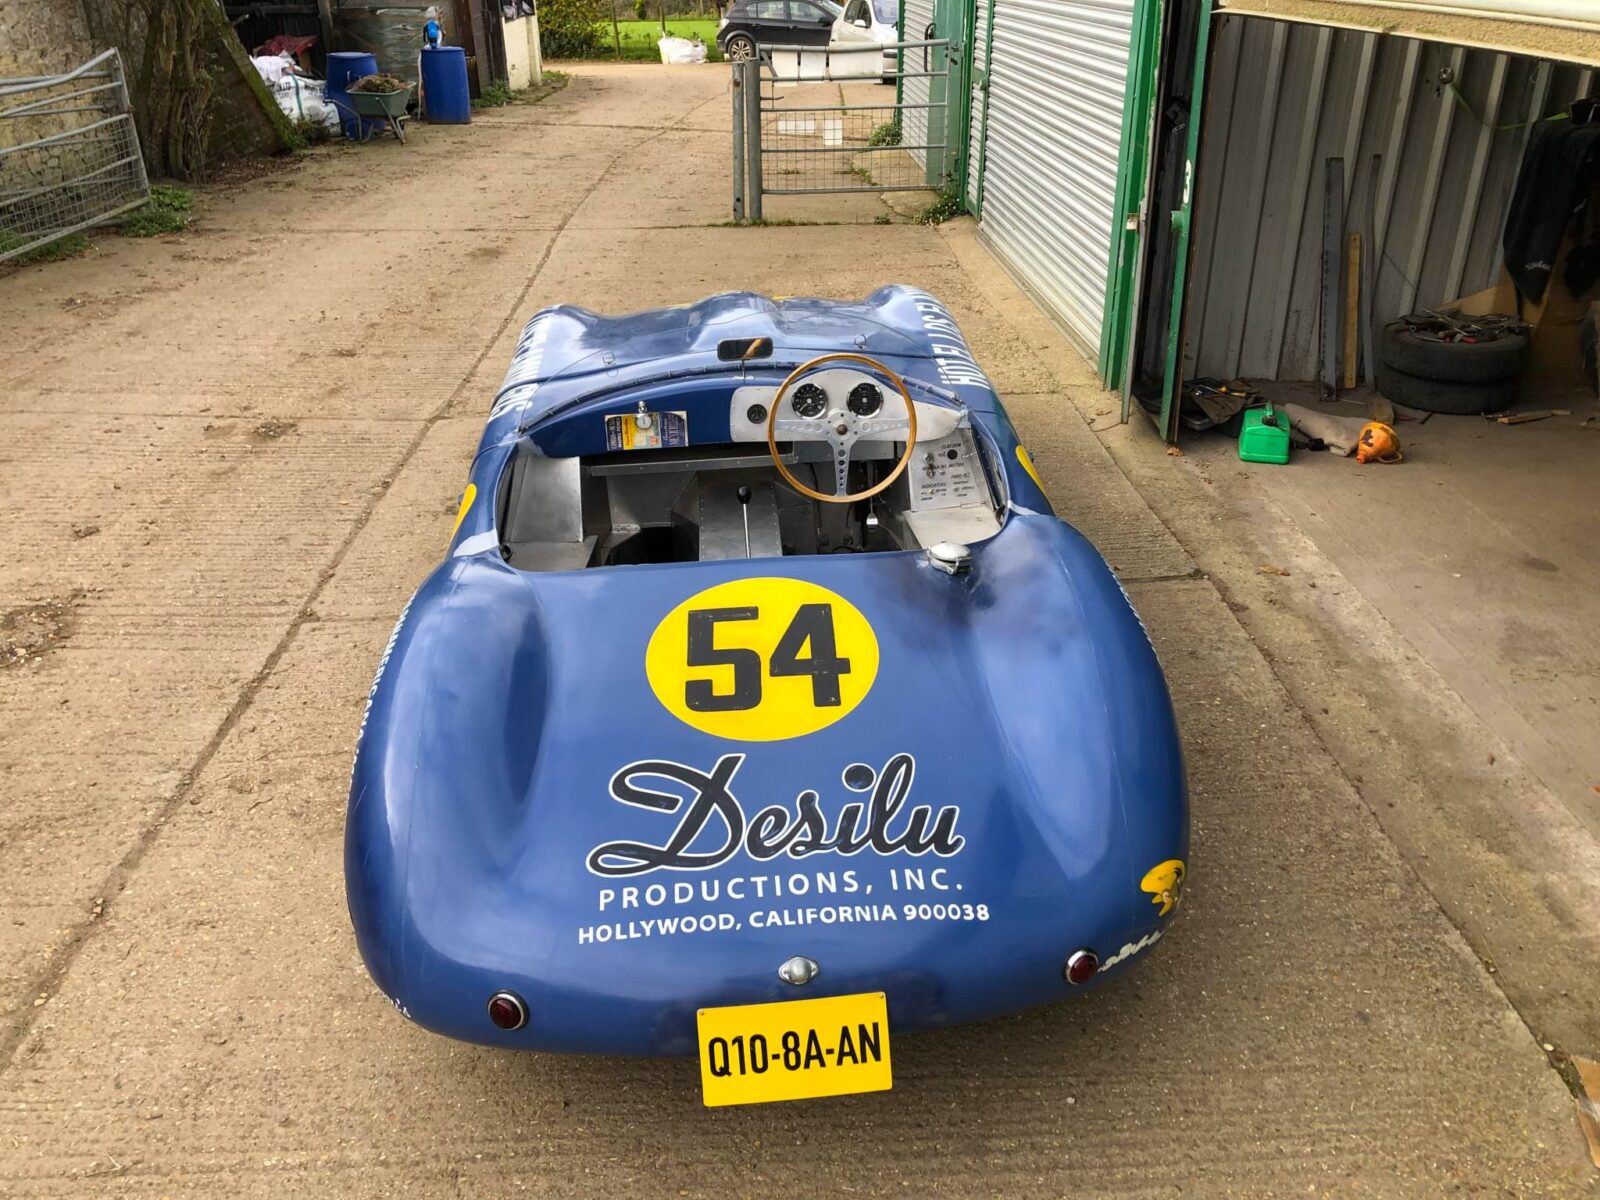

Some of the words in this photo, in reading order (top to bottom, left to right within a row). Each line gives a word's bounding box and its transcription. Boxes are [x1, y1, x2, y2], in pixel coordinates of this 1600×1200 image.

[1183, 159, 1192, 204] 3
[931, 343, 992, 390] HOTEL
[685, 603, 851, 712] 54
[586, 753, 966, 878] Desilu
[599, 870, 873, 911] PRODUCTIONS,
[890, 868, 963, 891] INC.
[578, 913, 742, 944] HOLLYWOOD,
[749, 904, 898, 928] CALIFORNIA
[903, 903, 991, 922] 900038
[708, 1021, 882, 1078] Q10-8A-AN
